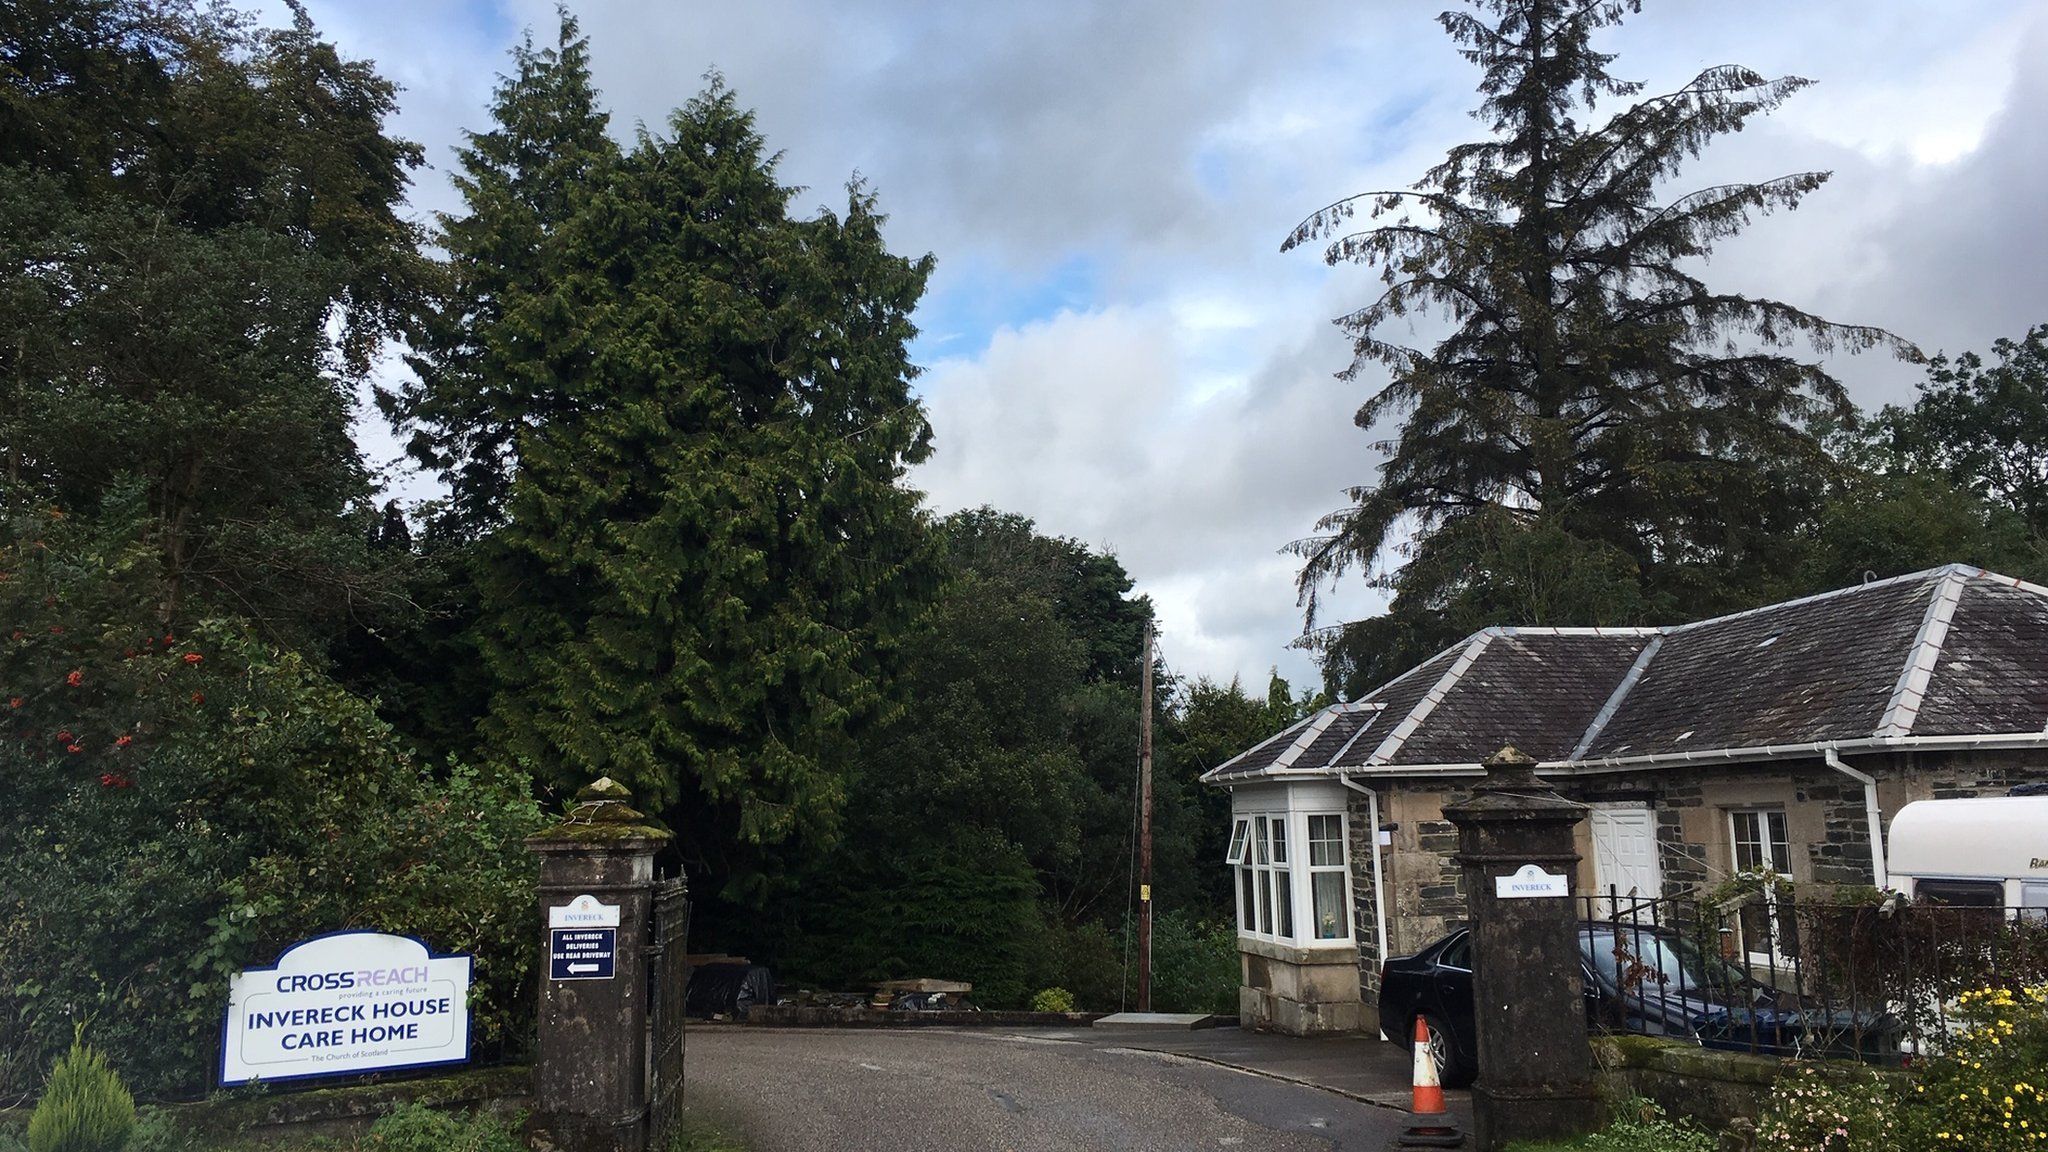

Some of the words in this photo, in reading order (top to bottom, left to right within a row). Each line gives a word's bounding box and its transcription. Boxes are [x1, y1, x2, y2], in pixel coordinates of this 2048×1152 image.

[1511, 883, 1552, 892] INVERECK
[564, 913, 604, 922] INVERECK
[562, 933, 573, 941] ALL
[574, 933, 604, 941] INVERECK
[565, 942, 600, 950] DELIVERIES
[553, 952, 565, 960] USE
[565, 951, 581, 960] REAR
[582, 951, 612, 959] DRIVEWAY
[338, 990, 373, 1000] providing
[381, 988, 404, 996] caring
[248, 1003, 366, 1030] INVERECK
[373, 998, 450, 1019] HOUSE
[281, 1029, 344, 1050] CARE
[351, 1023, 419, 1045] HOME
[326, 1052, 351, 1061] Church
[360, 1049, 389, 1058] Scotland
